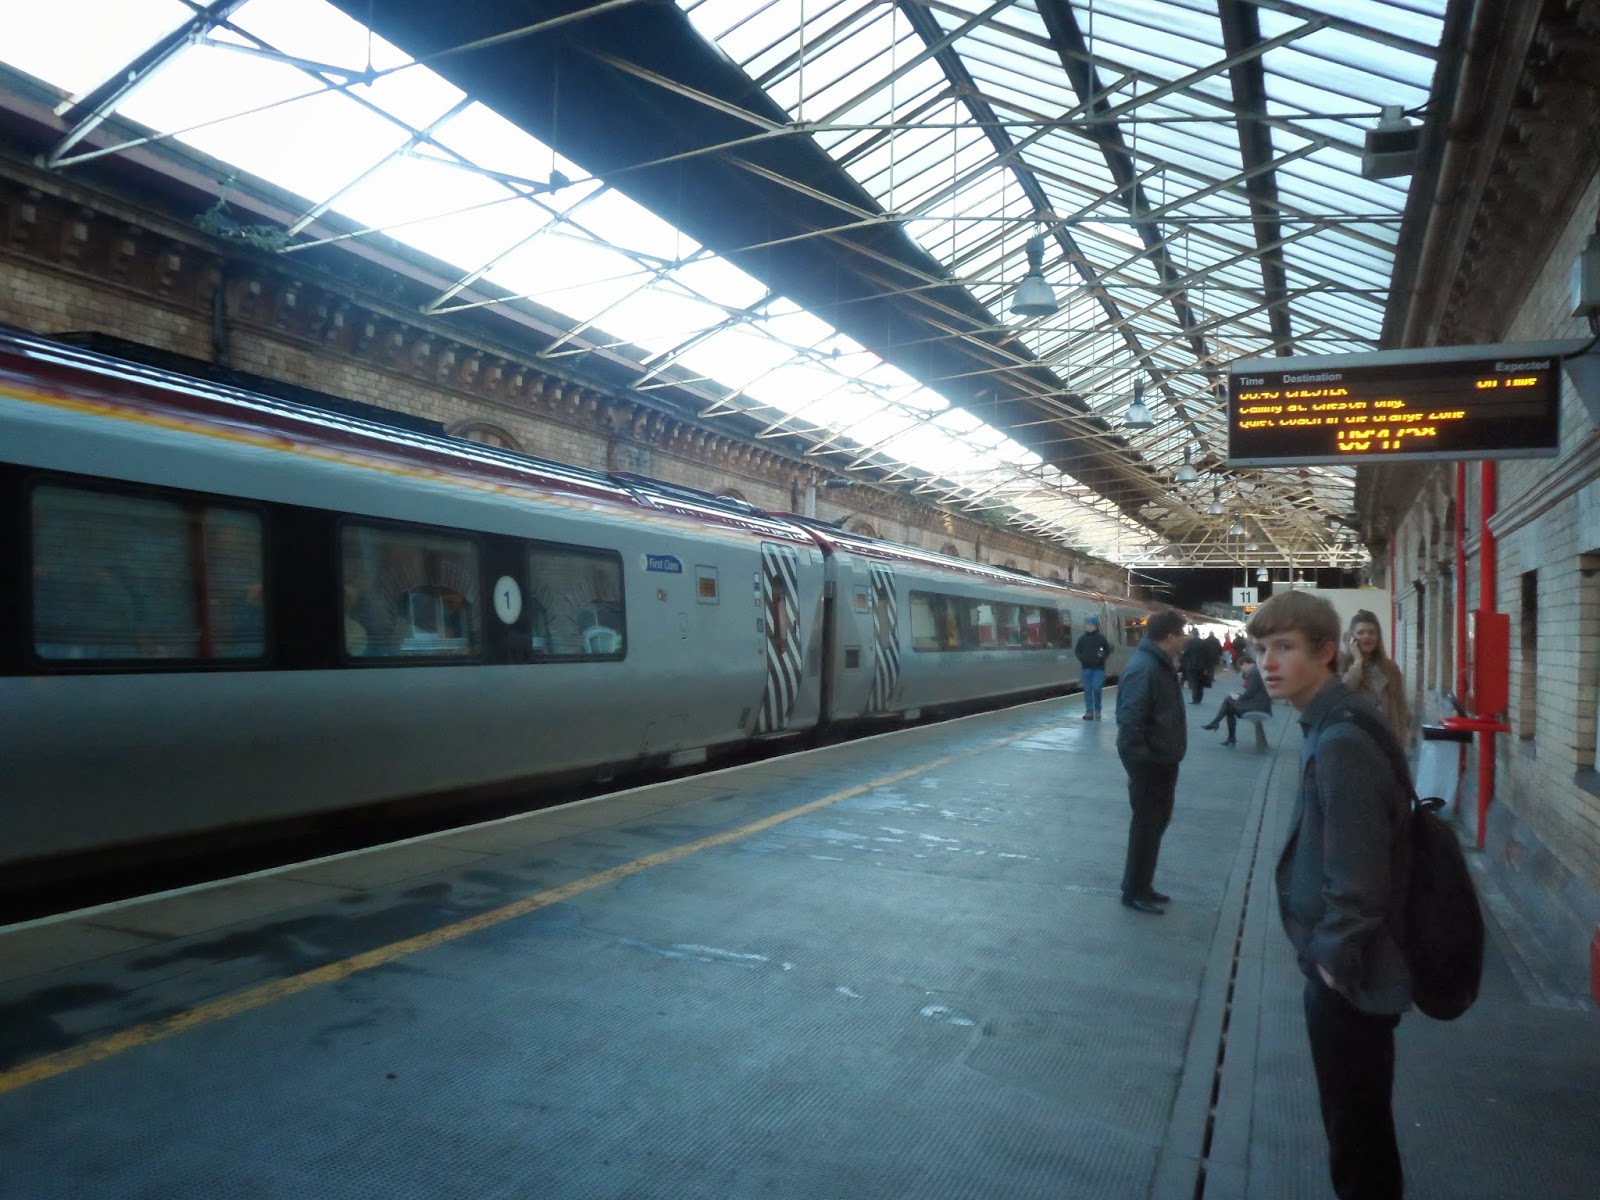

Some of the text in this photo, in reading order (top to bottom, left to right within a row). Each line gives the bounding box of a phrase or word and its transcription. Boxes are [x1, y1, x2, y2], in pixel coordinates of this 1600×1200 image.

[1495, 360, 1550, 373] Expected
[1239, 373, 1343, 386] Time Destination
[649, 557, 680, 572] First Class
[503, 590, 511, 610] 1
[1239, 590, 1252, 604] 11
